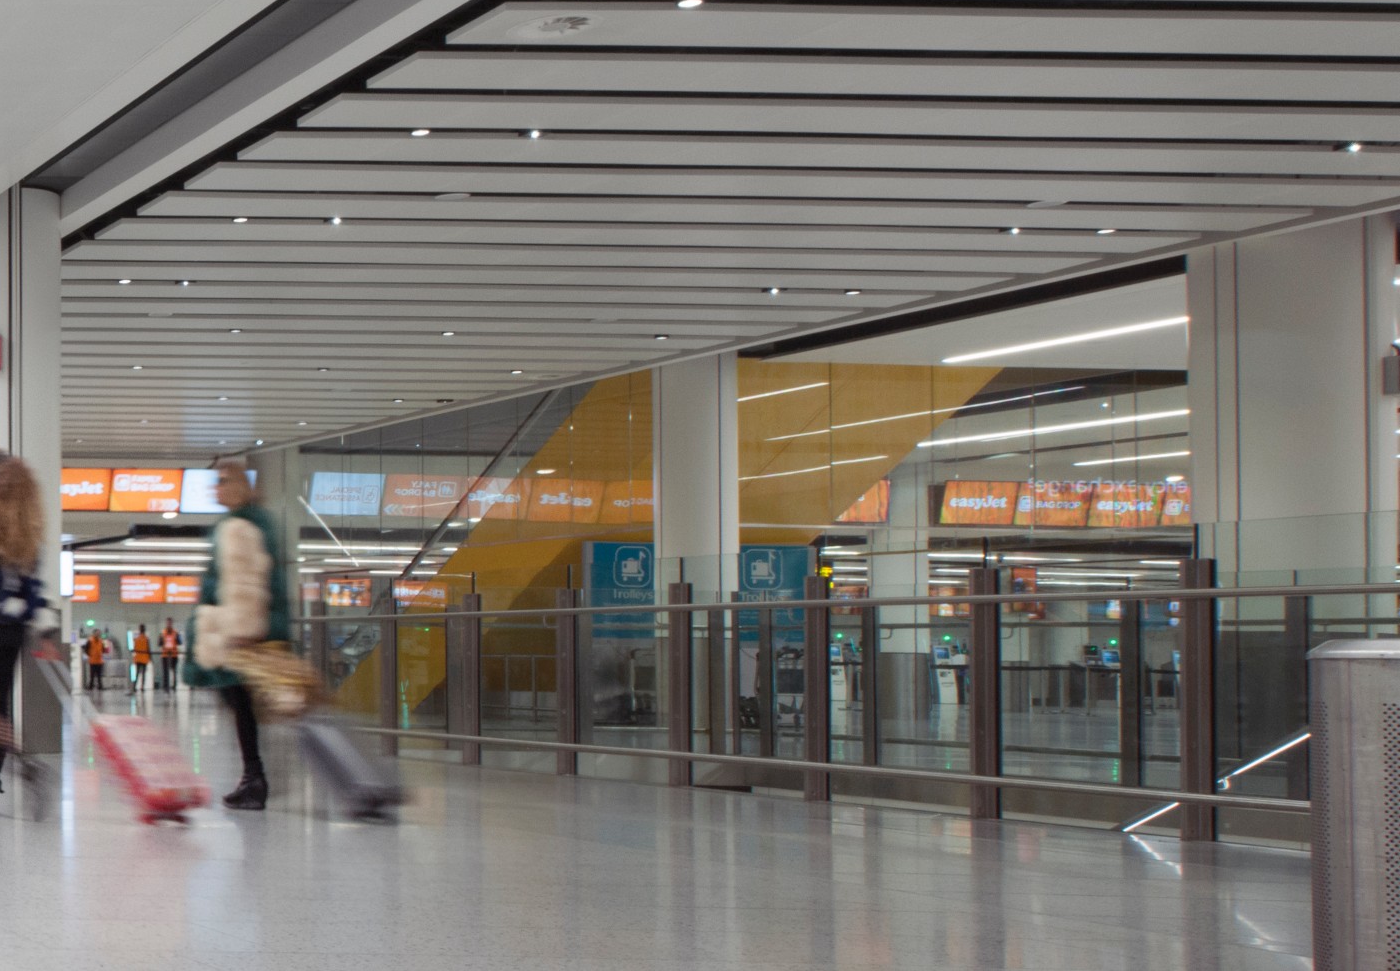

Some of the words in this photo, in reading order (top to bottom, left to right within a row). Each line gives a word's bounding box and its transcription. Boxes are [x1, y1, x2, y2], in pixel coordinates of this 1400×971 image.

[950, 496, 1007, 509] easyJet
[1097, 499, 1152, 513] easyJet
[613, 589, 654, 602] Trolleys
